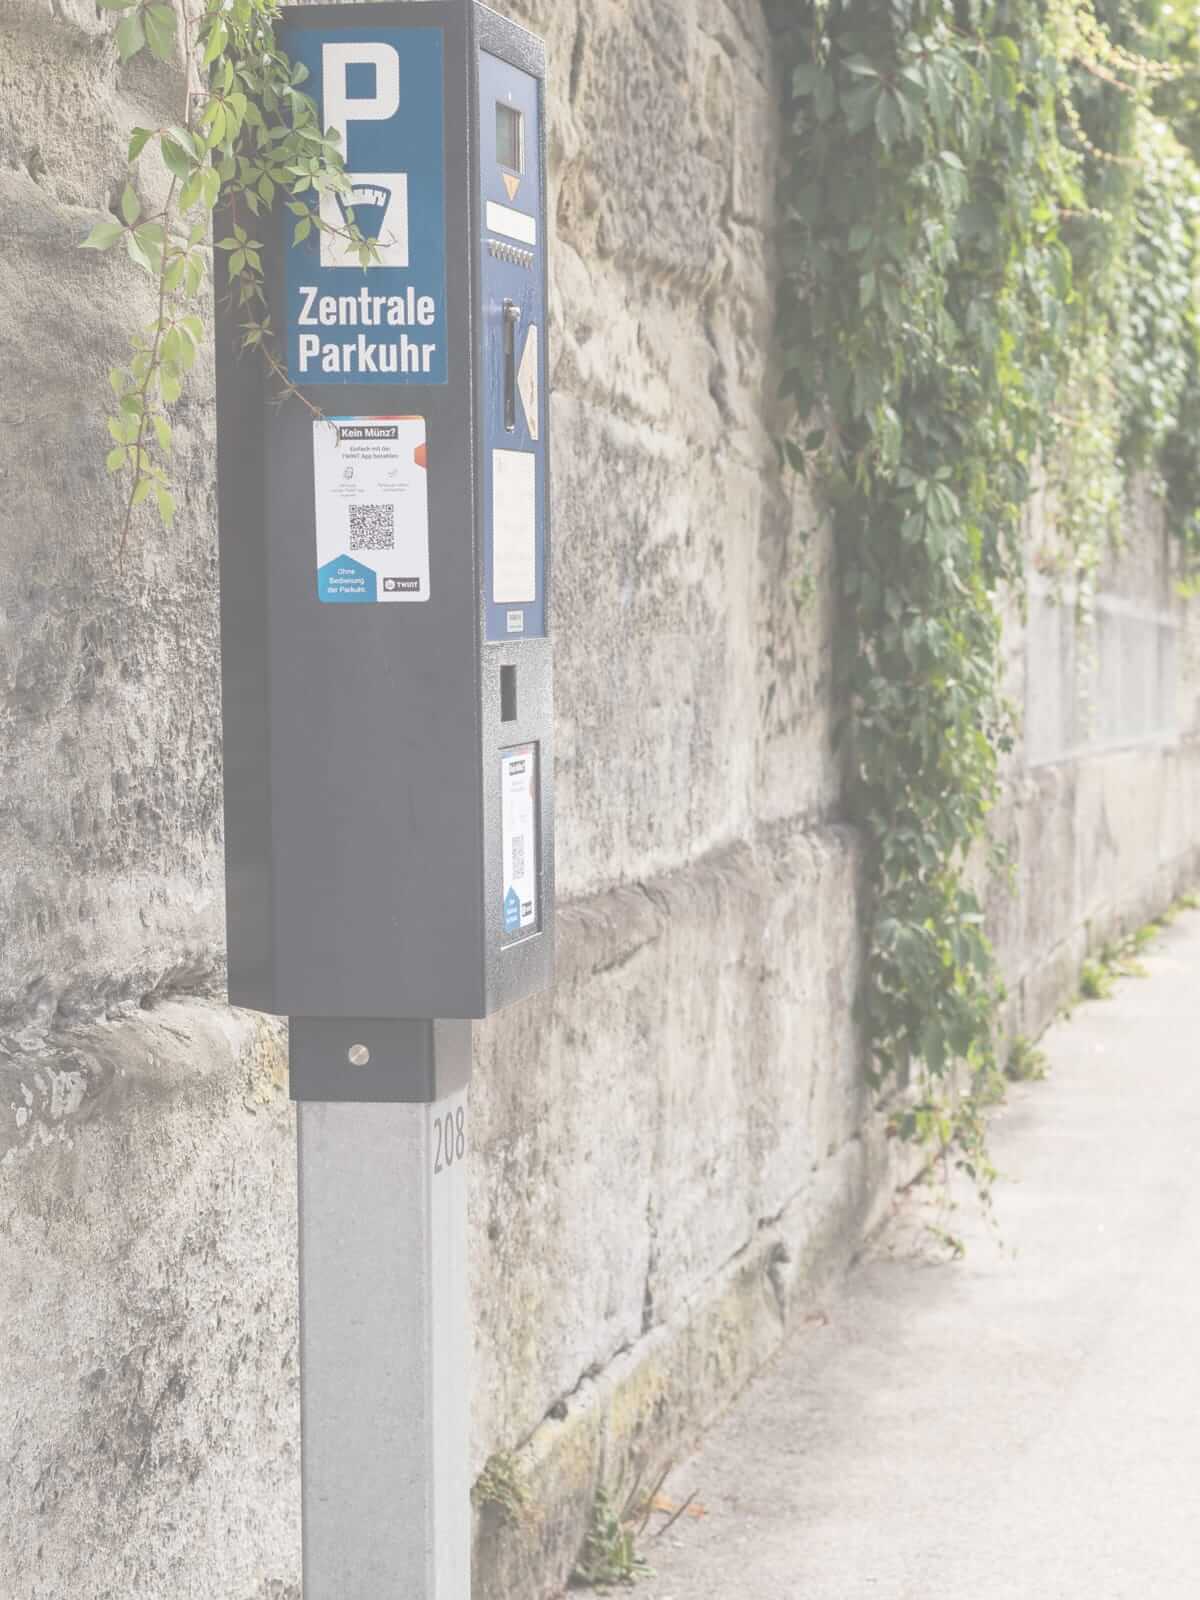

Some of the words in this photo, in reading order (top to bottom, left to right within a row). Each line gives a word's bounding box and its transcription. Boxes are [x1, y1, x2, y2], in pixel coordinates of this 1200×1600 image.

[322, 42, 400, 164] P
[298, 286, 435, 326] Zentrale
[298, 334, 436, 373] Parkuhr
[341, 428, 363, 438] Kein
[364, 427, 396, 438] Münz?
[434, 1107, 464, 1174] 208
